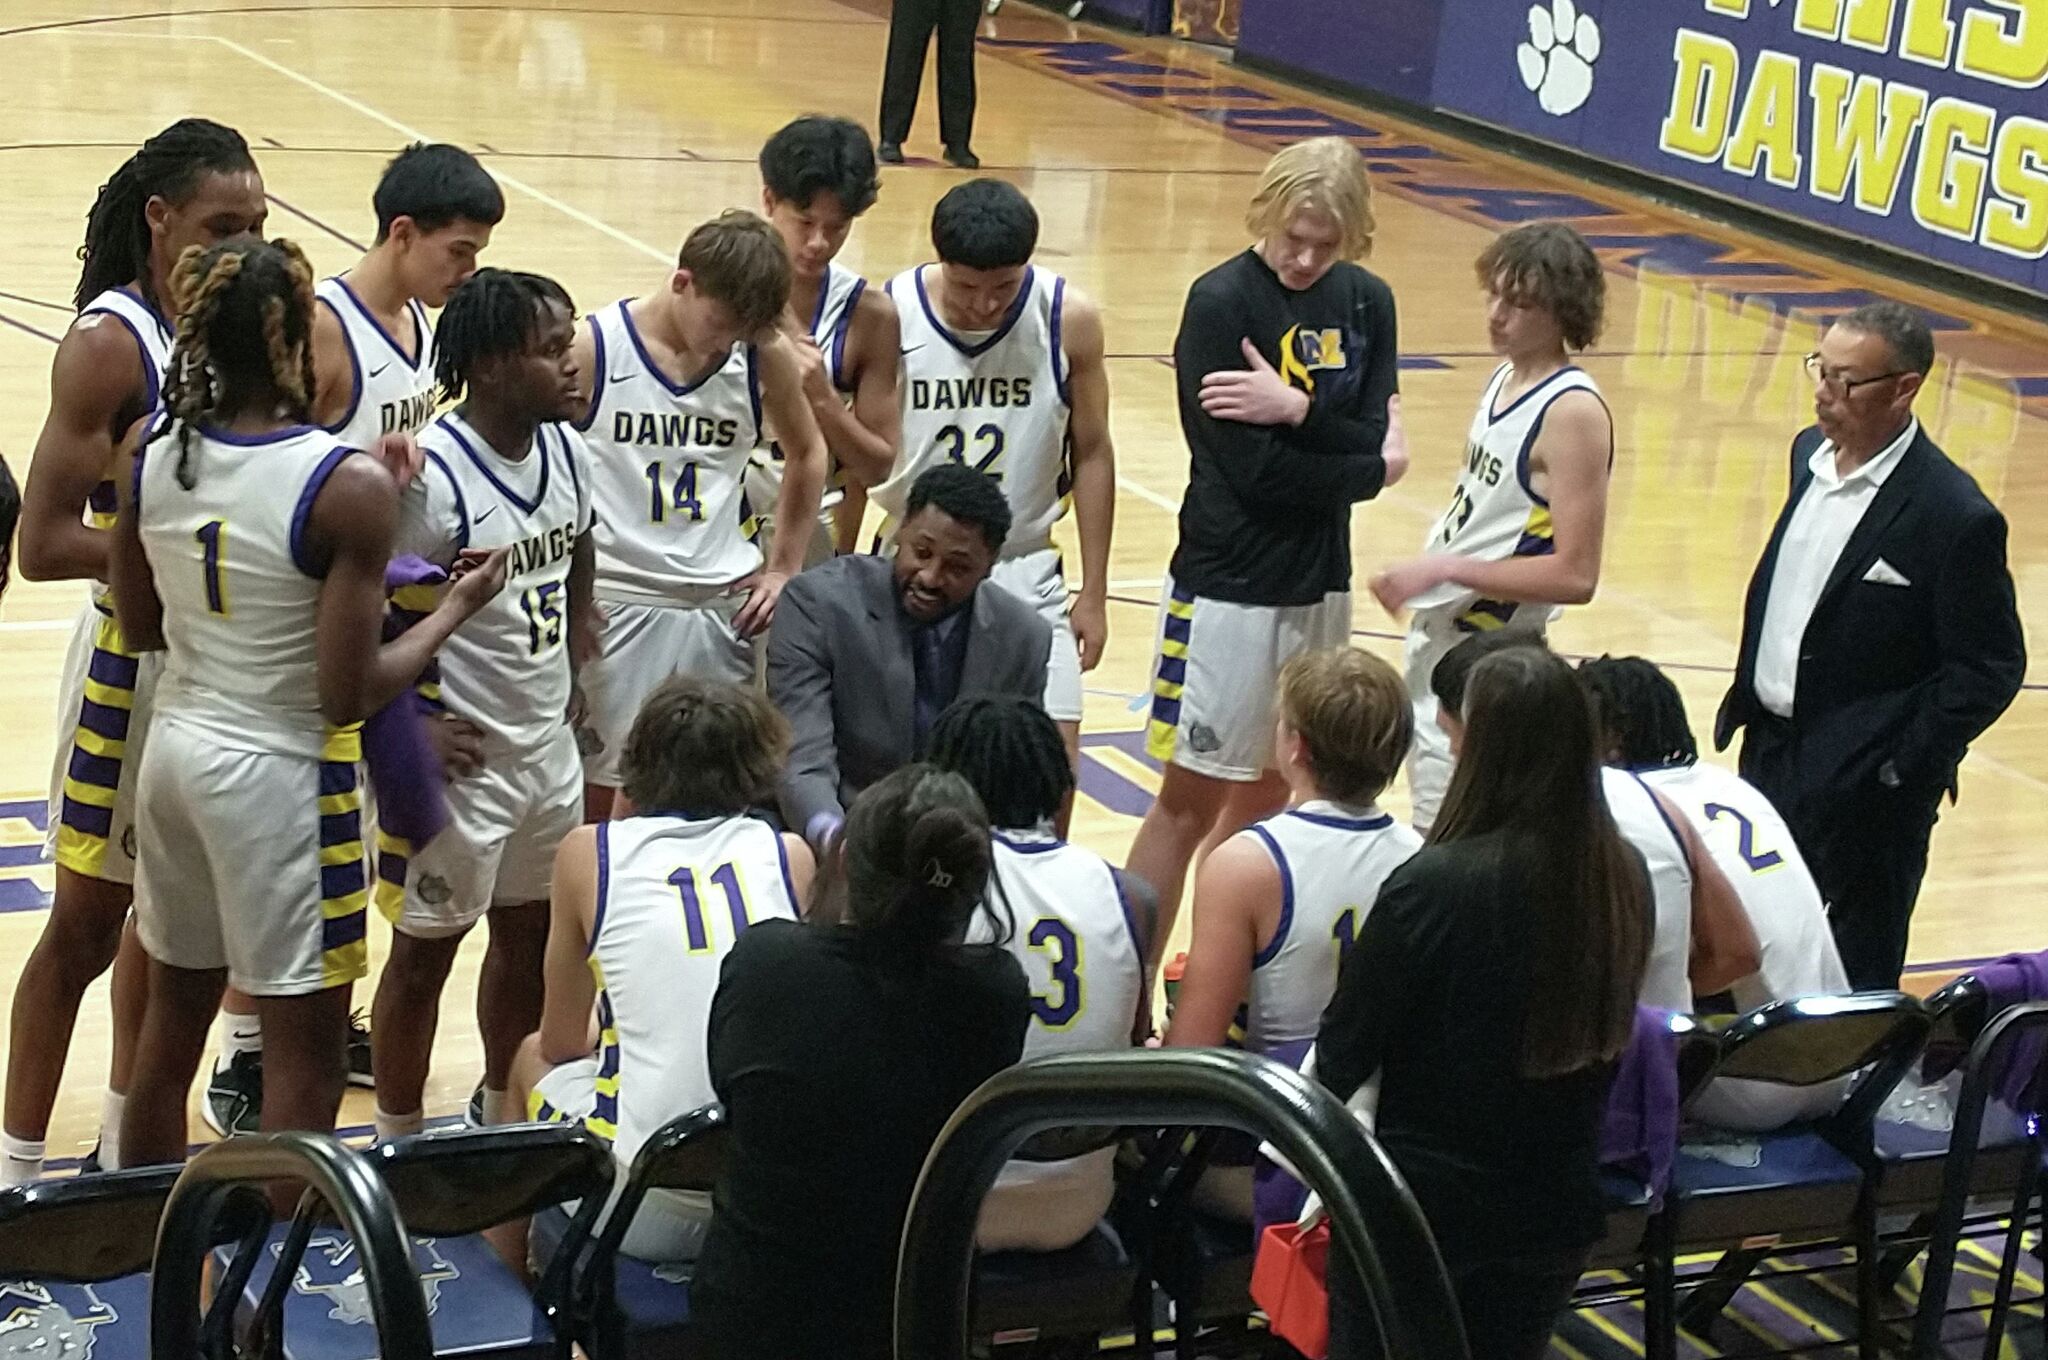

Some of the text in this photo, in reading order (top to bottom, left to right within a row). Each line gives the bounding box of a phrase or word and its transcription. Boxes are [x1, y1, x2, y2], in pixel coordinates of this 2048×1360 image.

[1659, 28, 2048, 259] DAWGS
[613, 410, 739, 447] DAWGS
[911, 377, 1032, 411] DAWGS
[934, 422, 1005, 482] 32
[645, 460, 706, 524] 14
[194, 518, 230, 617] 1
[503, 521, 576, 580] AWGS
[520, 580, 561, 656] 15
[1703, 801, 1785, 875] 2
[667, 861, 753, 954] 11
[1028, 915, 1086, 1033] 3
